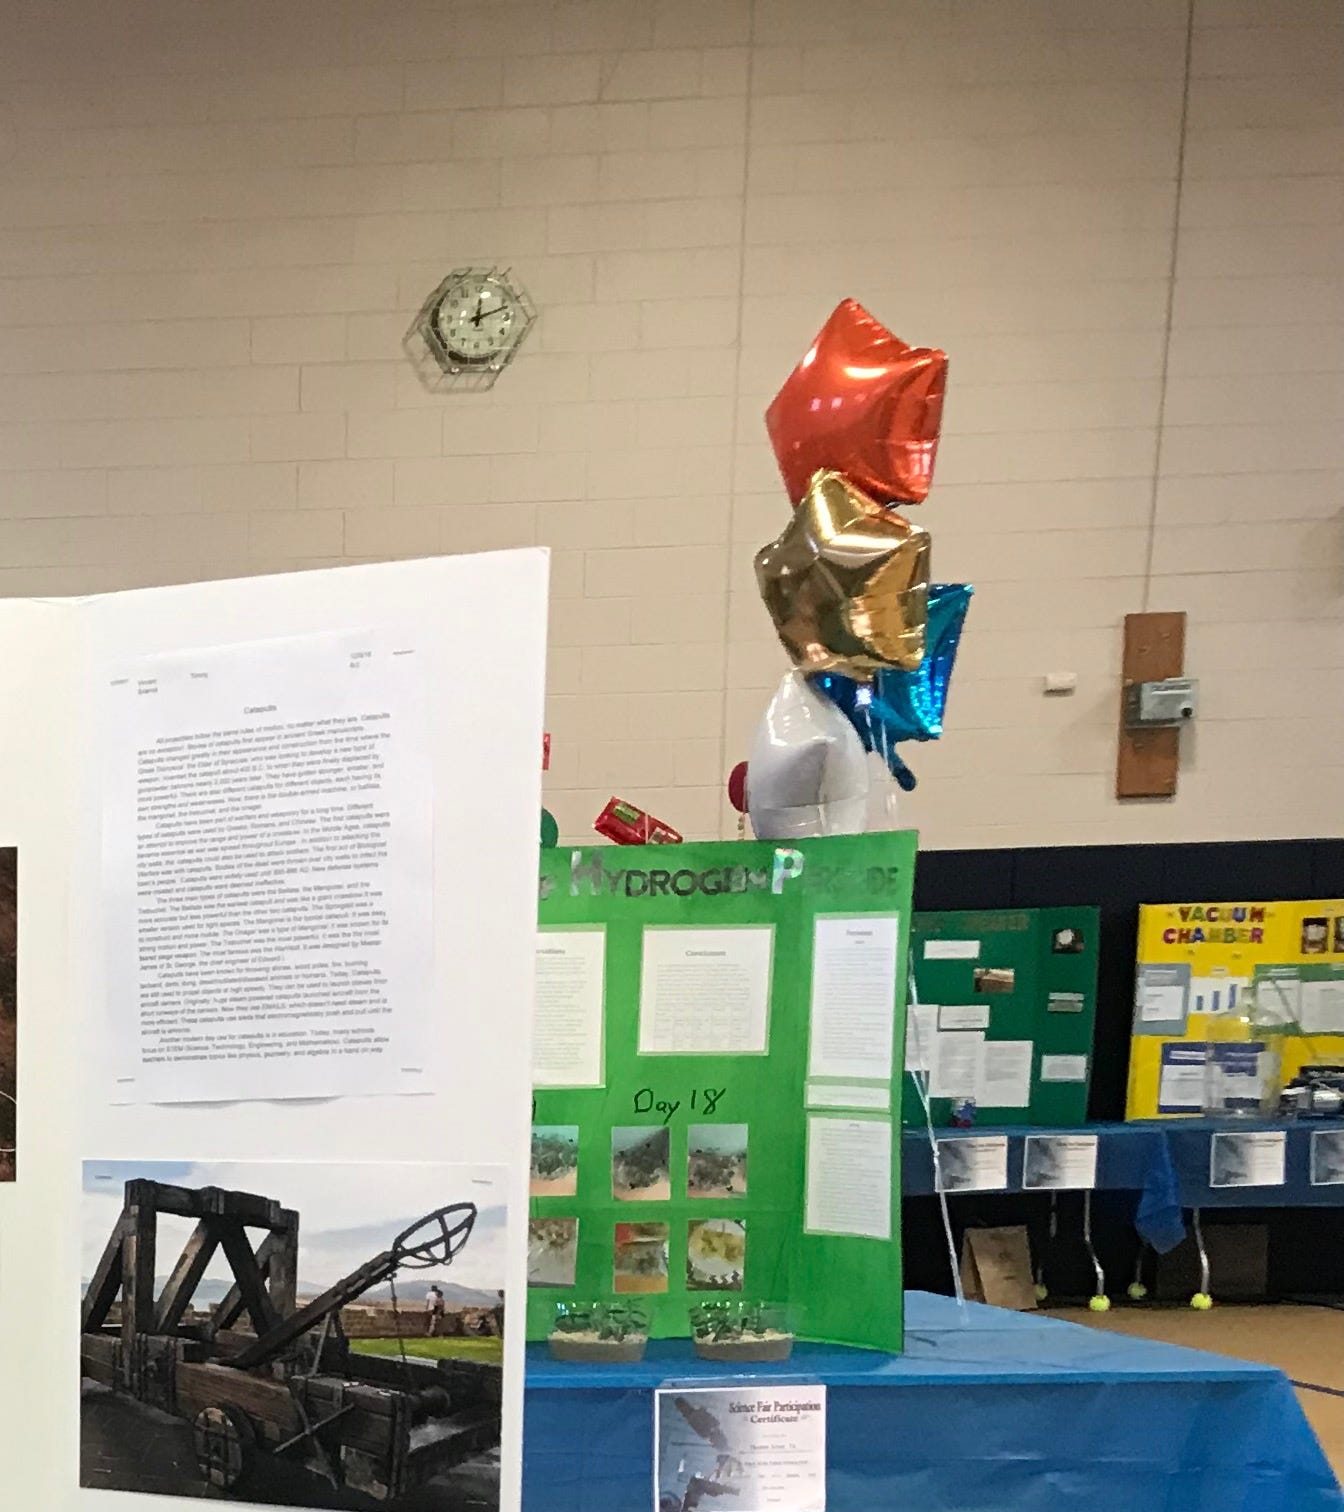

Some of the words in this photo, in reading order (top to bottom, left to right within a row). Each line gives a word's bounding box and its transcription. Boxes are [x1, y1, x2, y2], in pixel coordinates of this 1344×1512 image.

[634, 1088, 680, 1125] Day
[691, 1088, 726, 1115] 18
[756, 1400, 772, 1413] Fair
